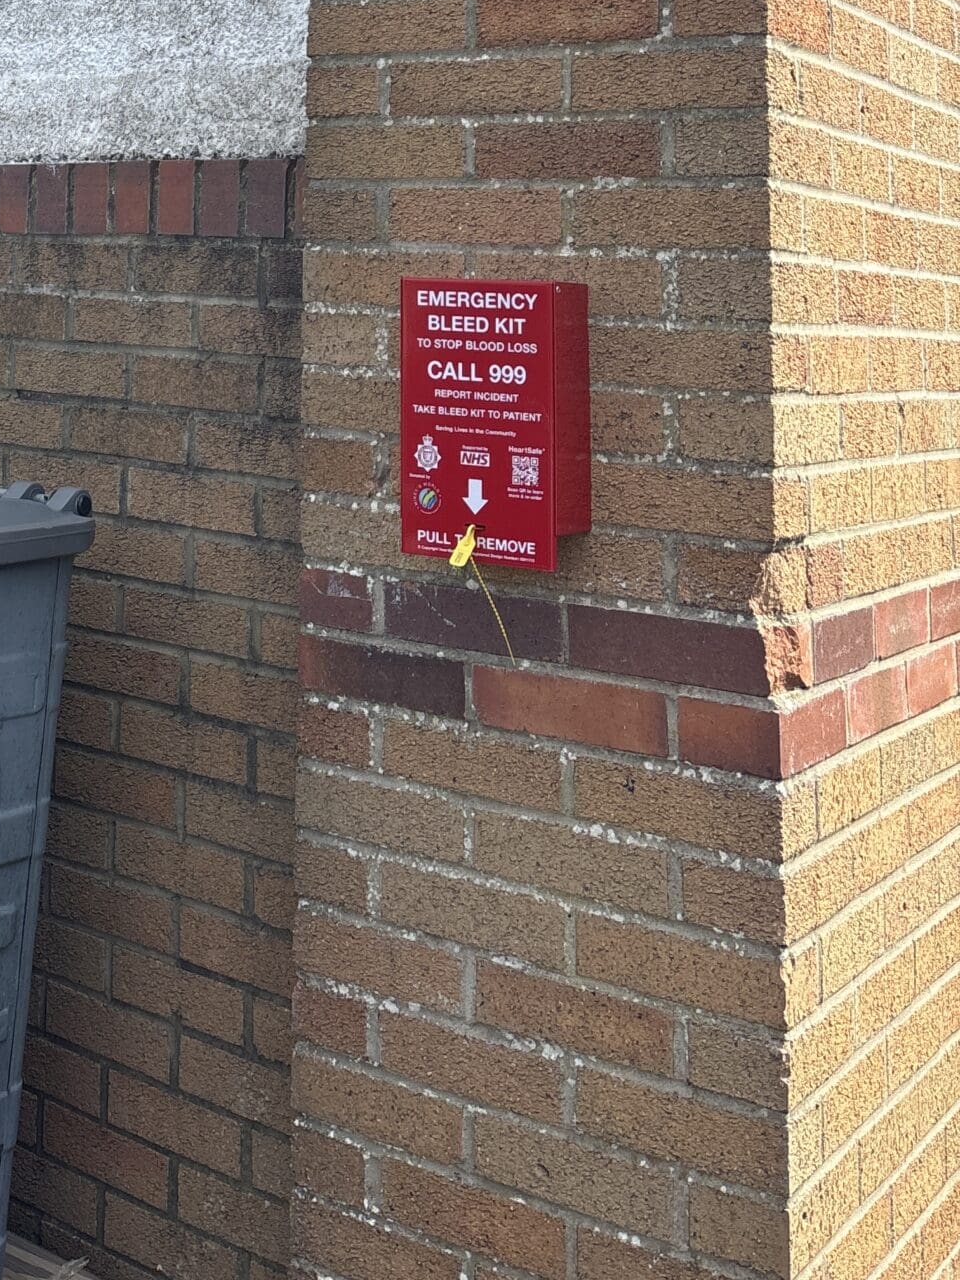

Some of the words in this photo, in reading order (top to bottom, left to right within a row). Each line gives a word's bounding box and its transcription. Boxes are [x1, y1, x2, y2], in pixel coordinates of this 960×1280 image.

[417, 290, 538, 310] EMERGENCY
[428, 315, 489, 333] BLEED
[495, 318, 526, 335] KIT
[417, 338, 431, 348] TO
[434, 339, 462, 349] STOP
[466, 341, 504, 352] BLOOD
[508, 342, 538, 354] LOSS
[427, 360, 483, 382] CALL
[489, 364, 526, 384] 999
[434, 389, 472, 399] REPORT
[474, 391, 519, 402] INCIDENT
[413, 404, 436, 414] TAKE
[438, 406, 468, 417] BLEED
[471, 409, 486, 418] KIT
[488, 410, 500, 419] TO
[503, 411, 542, 422] PATIENT
[461, 452, 489, 465] NHS
[417, 530, 451, 545] PULL
[476, 536, 536, 555] REMOVE
